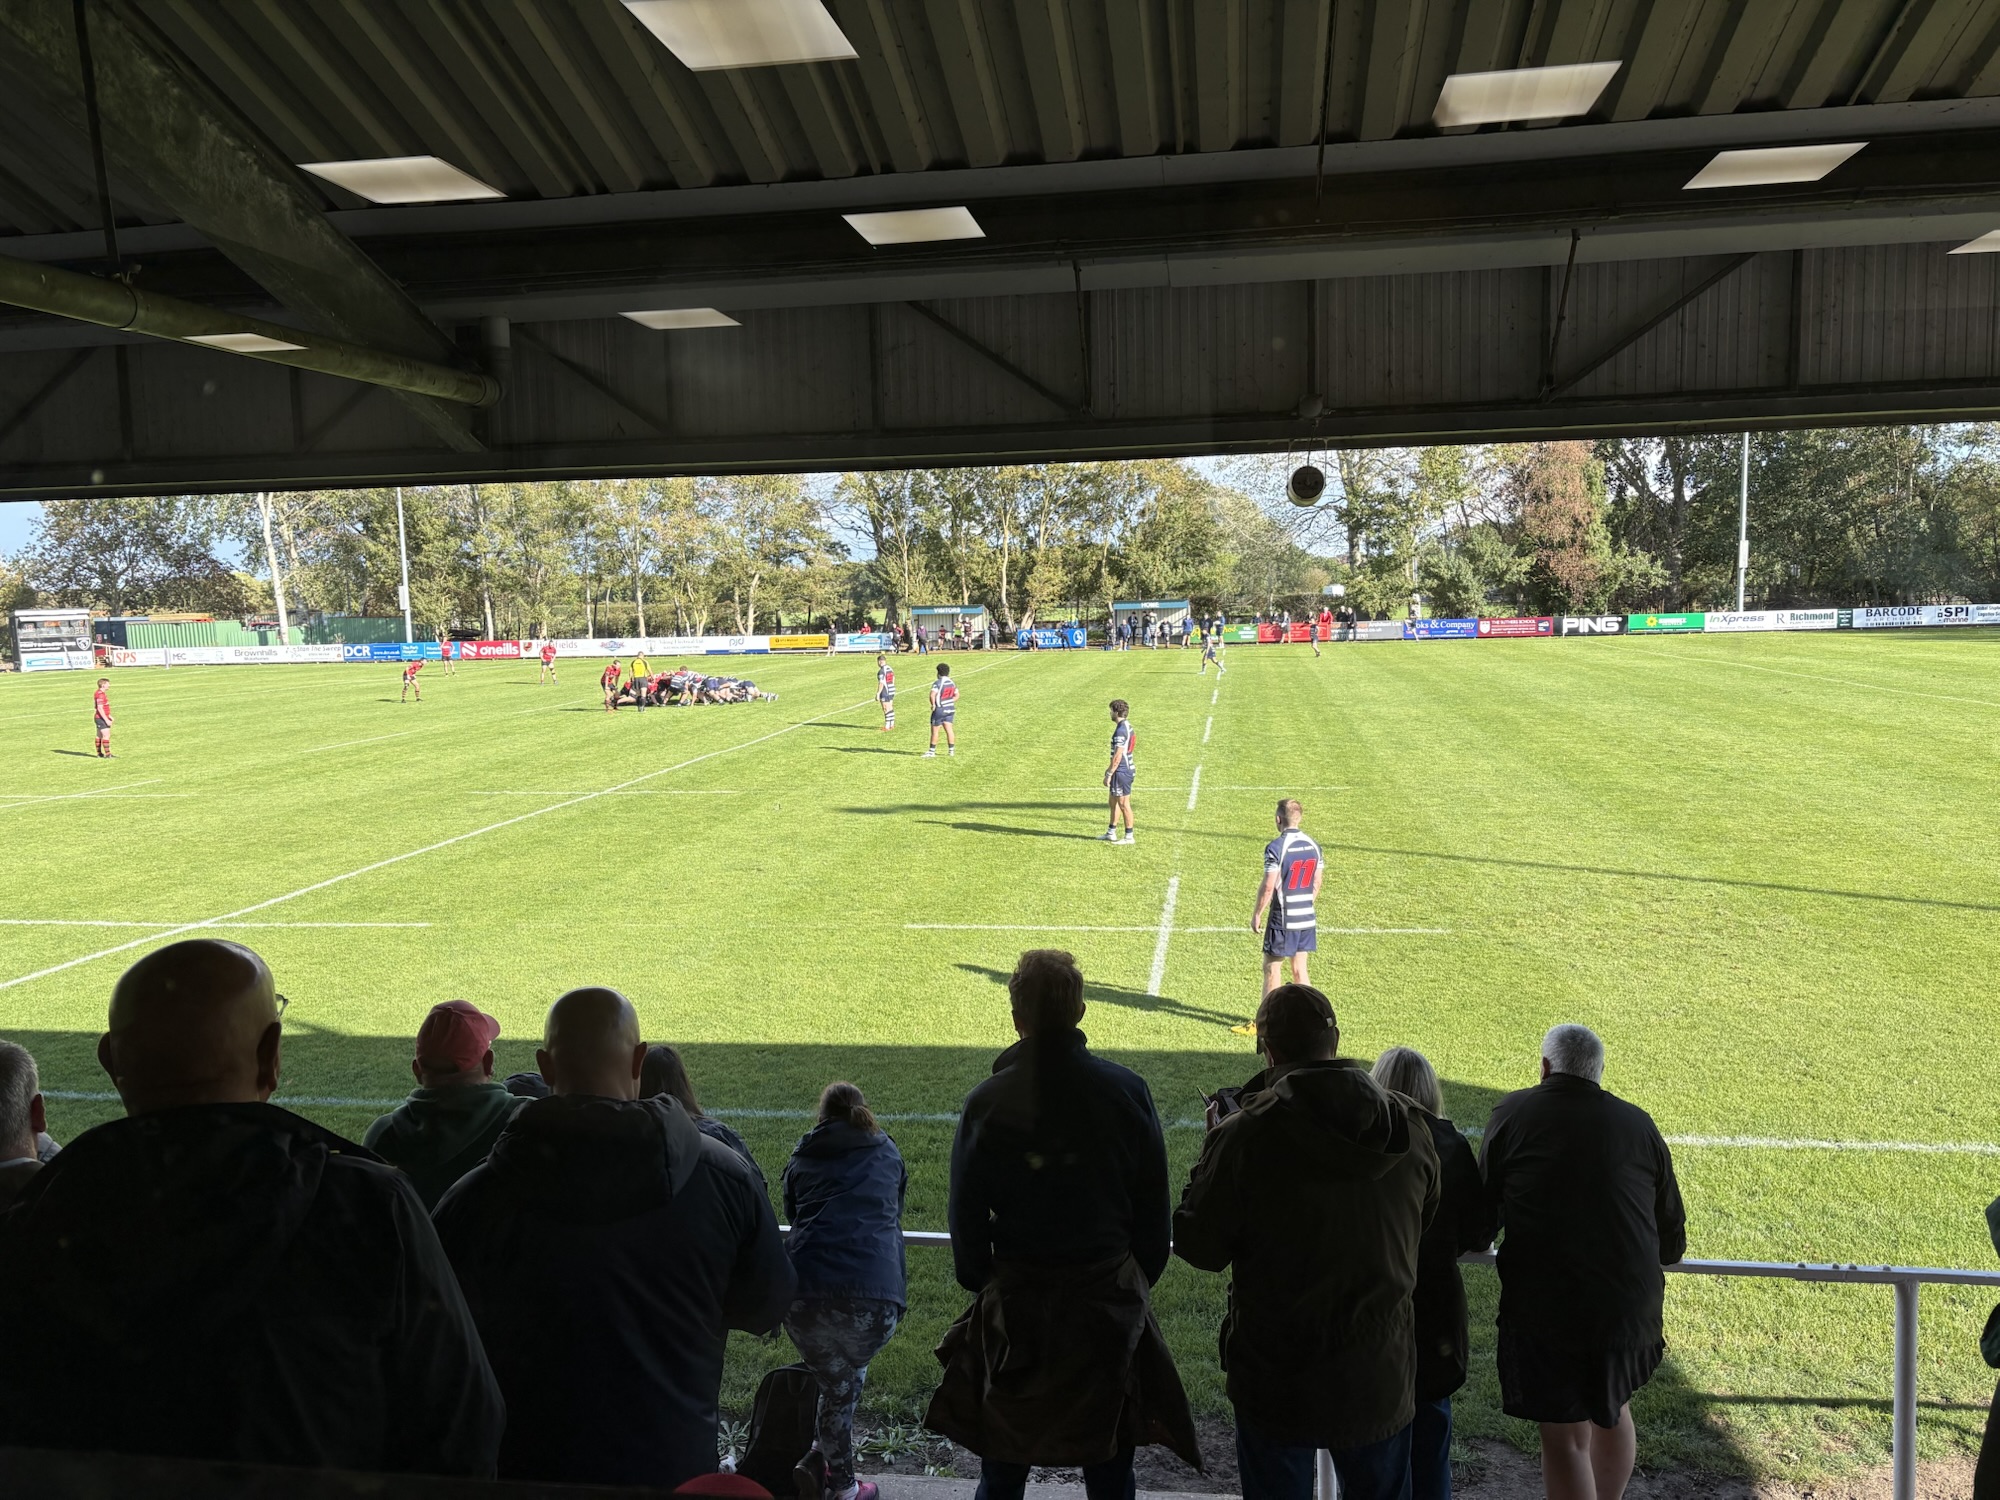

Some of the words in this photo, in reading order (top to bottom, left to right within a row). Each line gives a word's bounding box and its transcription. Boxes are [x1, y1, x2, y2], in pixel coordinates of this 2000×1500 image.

[1790, 612, 1835, 621] Richmond
[1865, 607, 1923, 617] BARCODE
[1944, 607, 1969, 617] SPI
[1430, 619, 1440, 629] &
[1440, 621, 1476, 630] Company
[1563, 617, 1620, 633] PING
[1709, 614, 1765, 625] InXpress
[234, 648, 278, 657] Brownhills
[344, 645, 371, 657] DCR
[115, 652, 137, 664] SPS
[1288, 858, 1317, 890] 11
